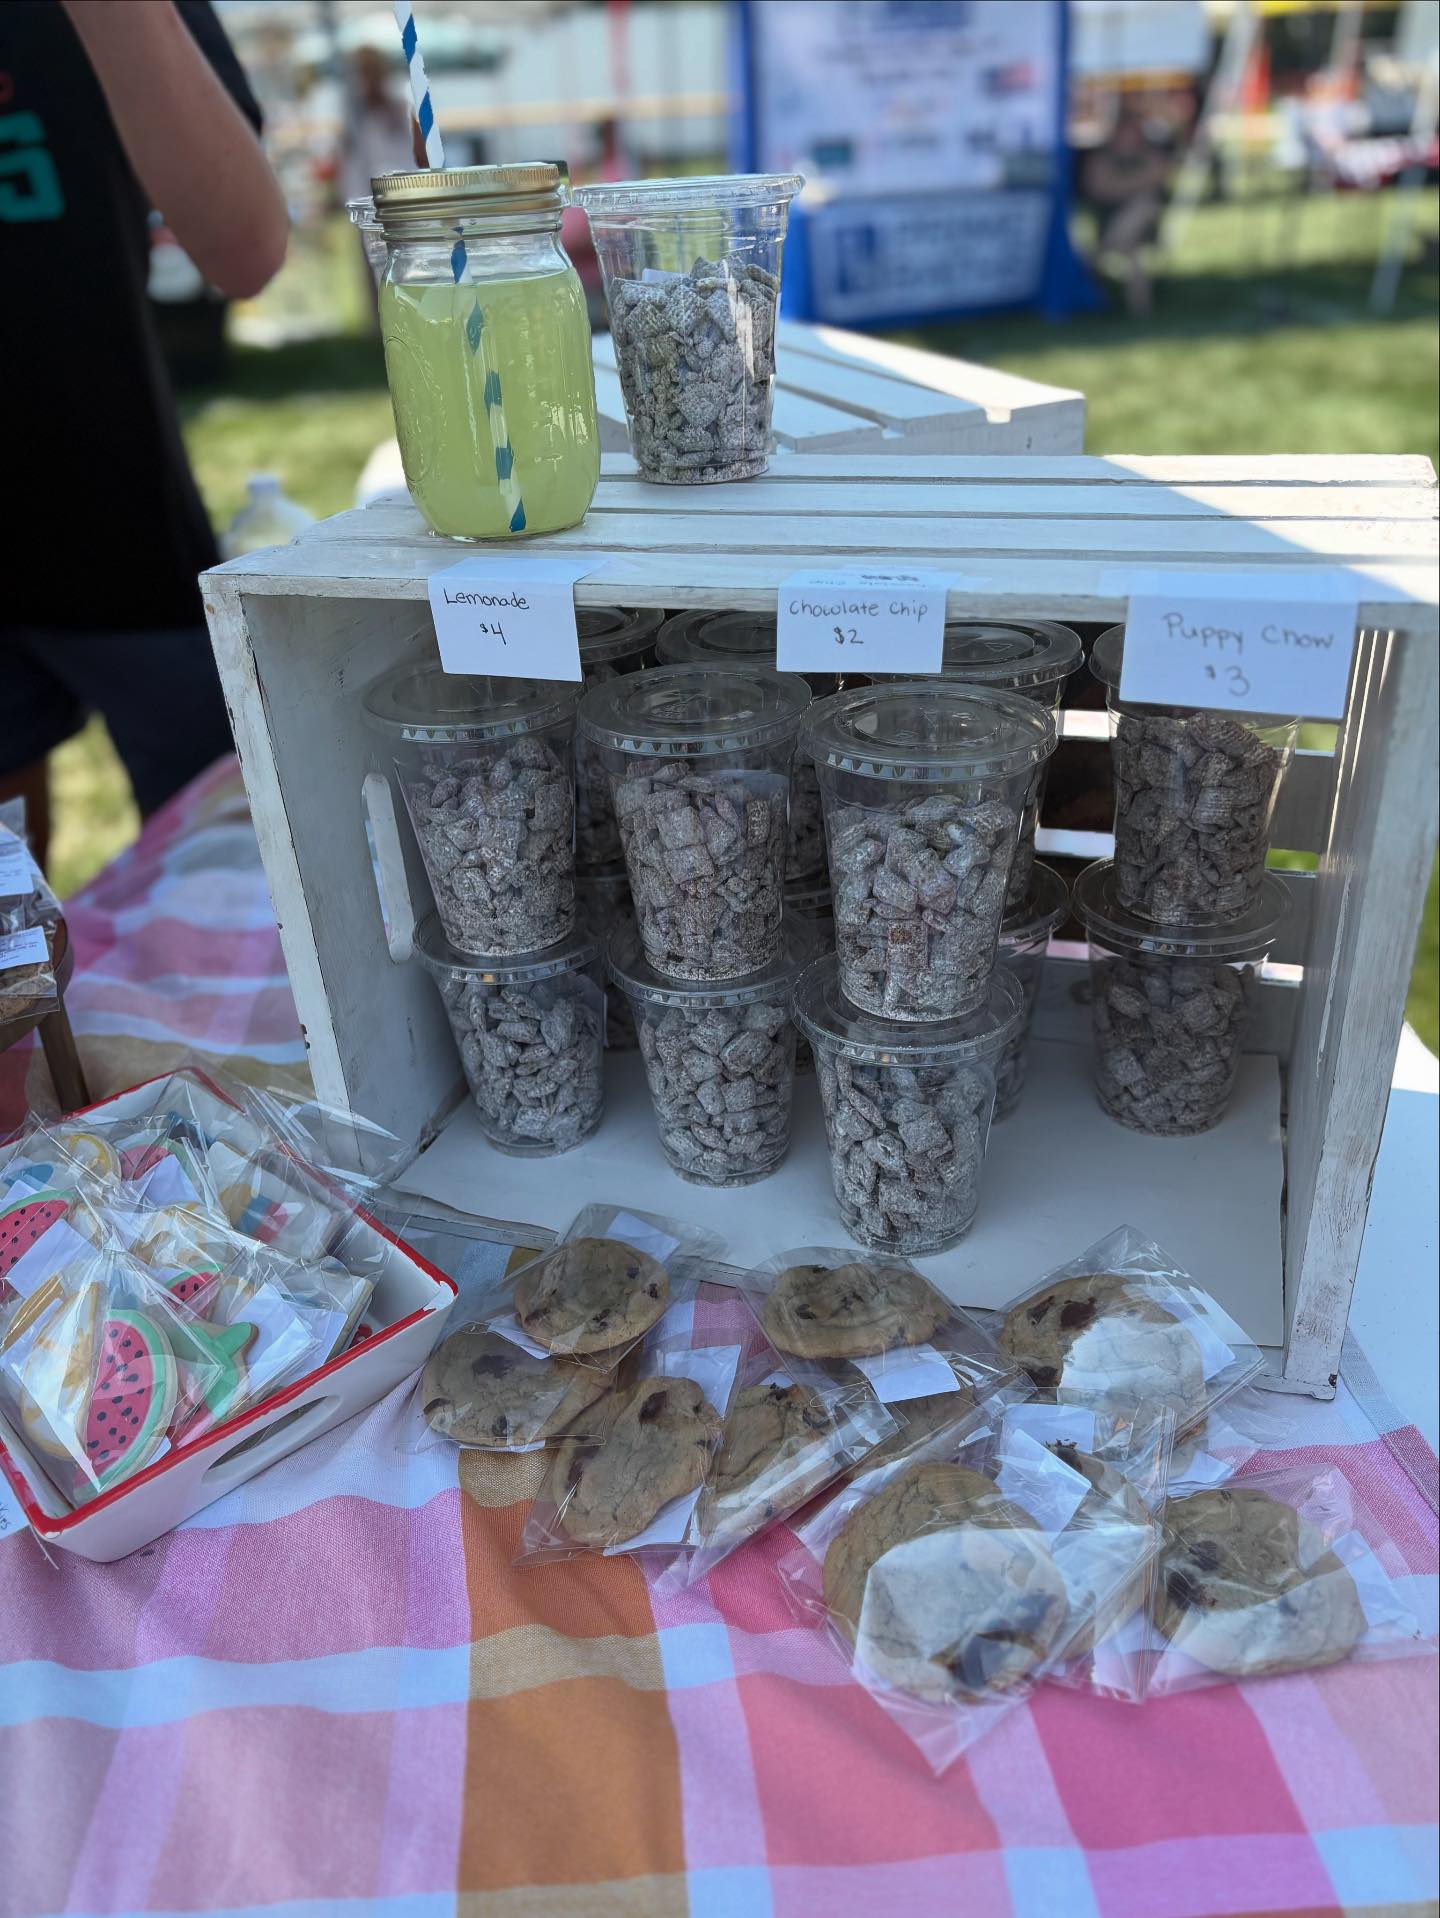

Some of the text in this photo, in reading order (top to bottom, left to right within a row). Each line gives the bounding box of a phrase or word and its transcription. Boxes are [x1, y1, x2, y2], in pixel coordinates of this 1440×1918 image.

[443, 587, 530, 609] Lemonade
[889, 600, 928, 622] Chip
[479, 622, 507, 646] $4
[833, 626, 864, 645] $2
[1161, 612, 1244, 654] Puppy
[1204, 664, 1250, 696] $3
